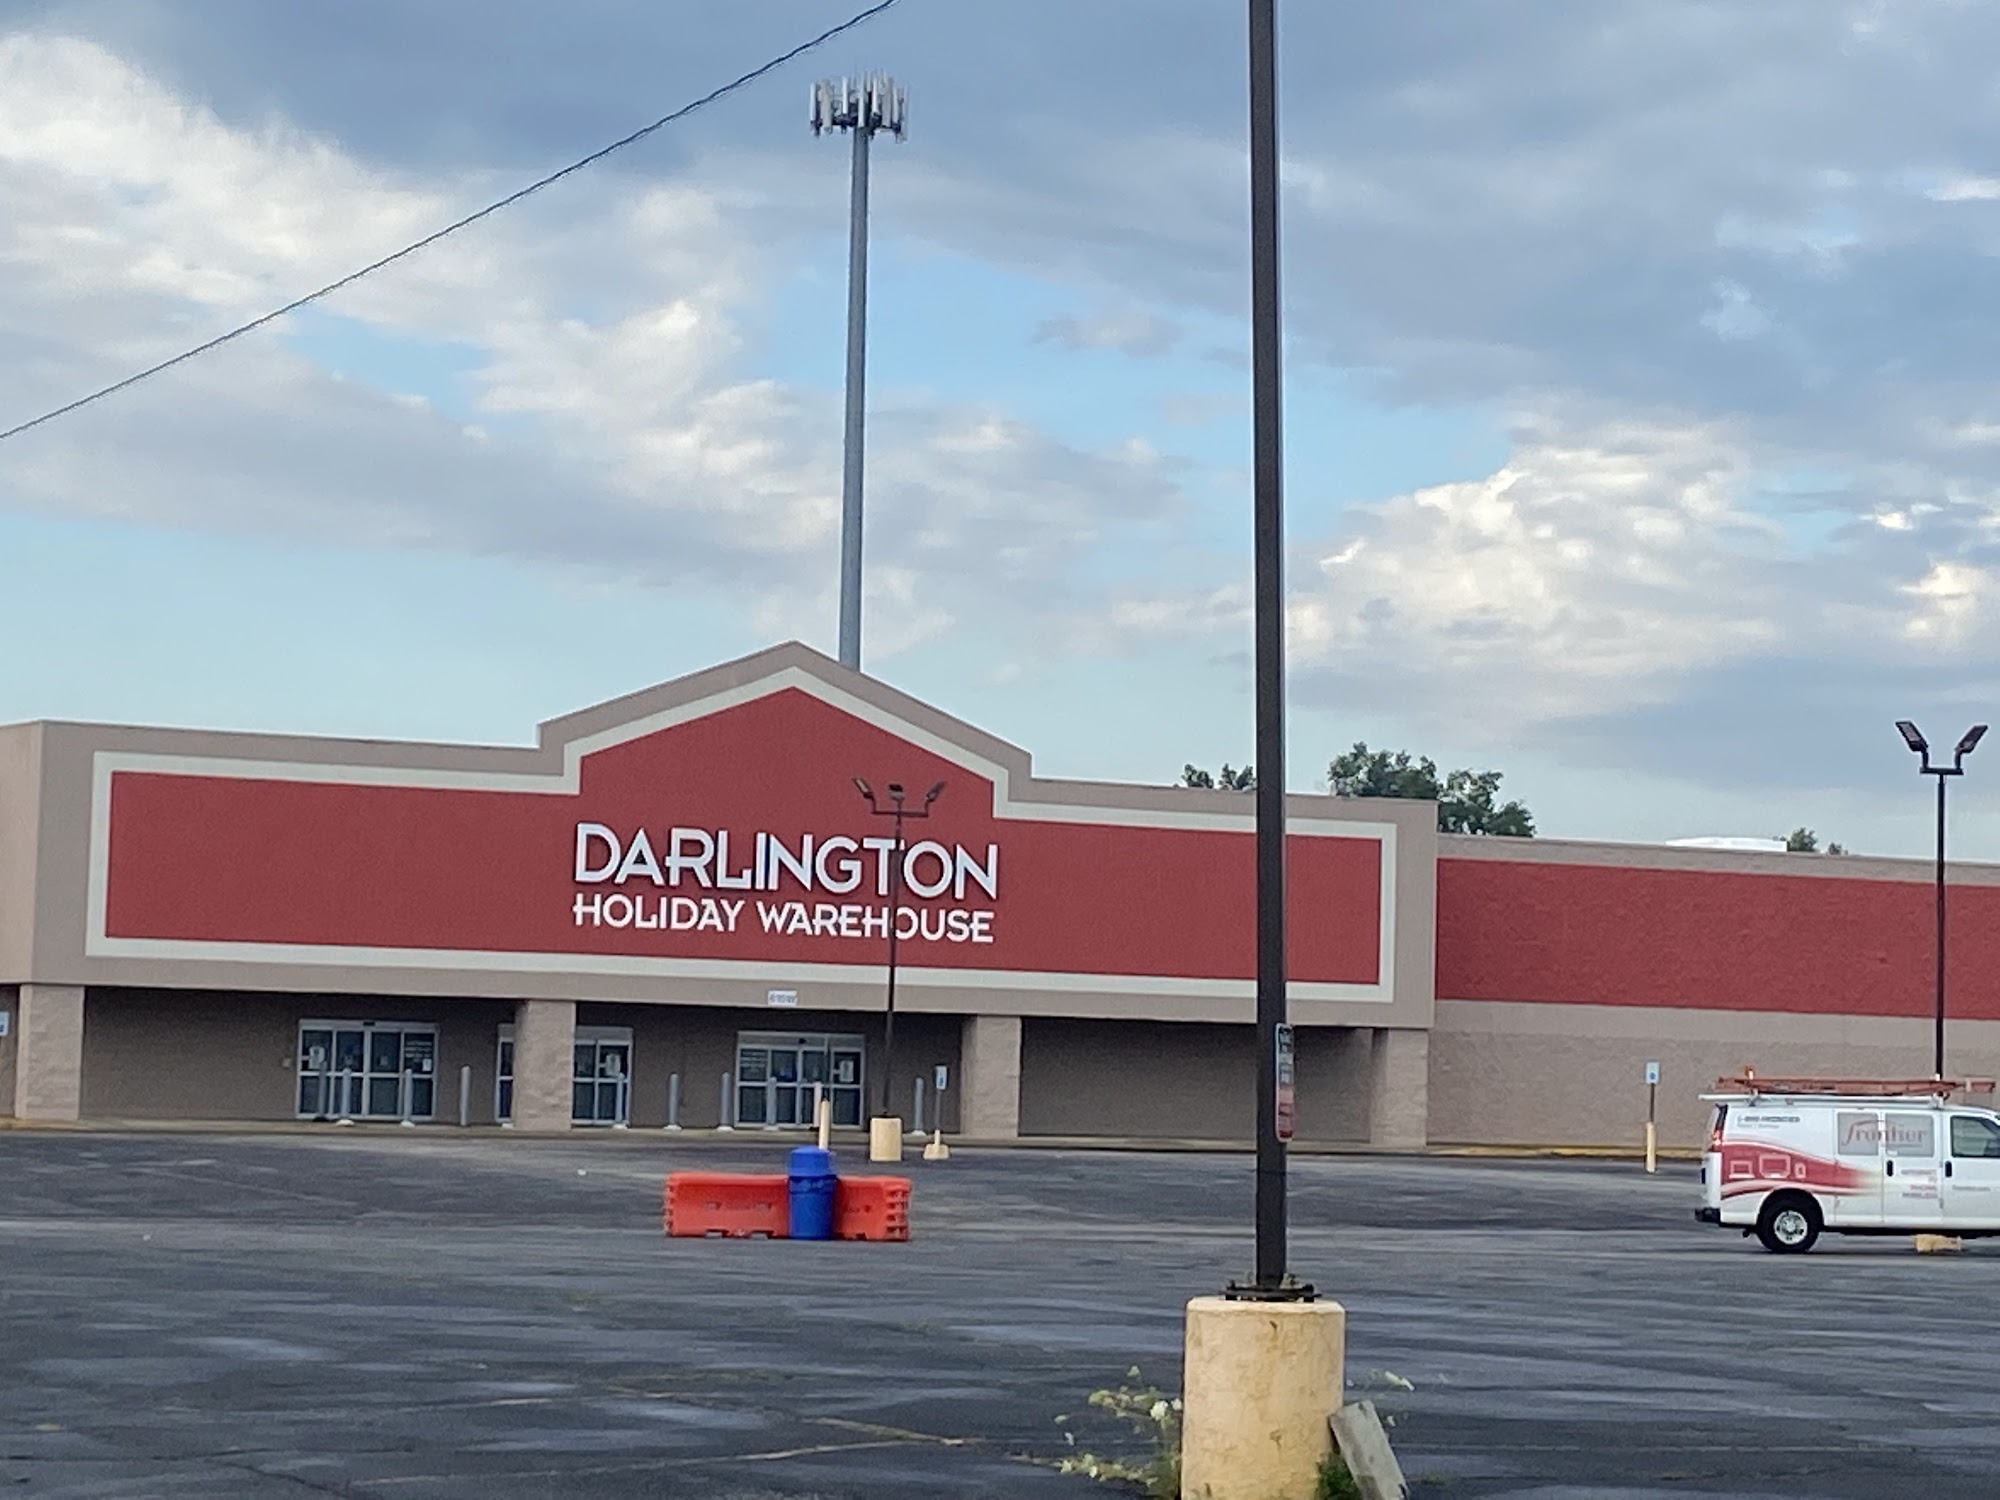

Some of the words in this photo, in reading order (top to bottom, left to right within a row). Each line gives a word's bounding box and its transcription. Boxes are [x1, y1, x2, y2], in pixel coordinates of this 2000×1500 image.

[575, 823, 997, 899] DARLINGTON
[573, 893, 745, 931] HOLIDAY
[756, 901, 994, 943] WAREHOUSE
